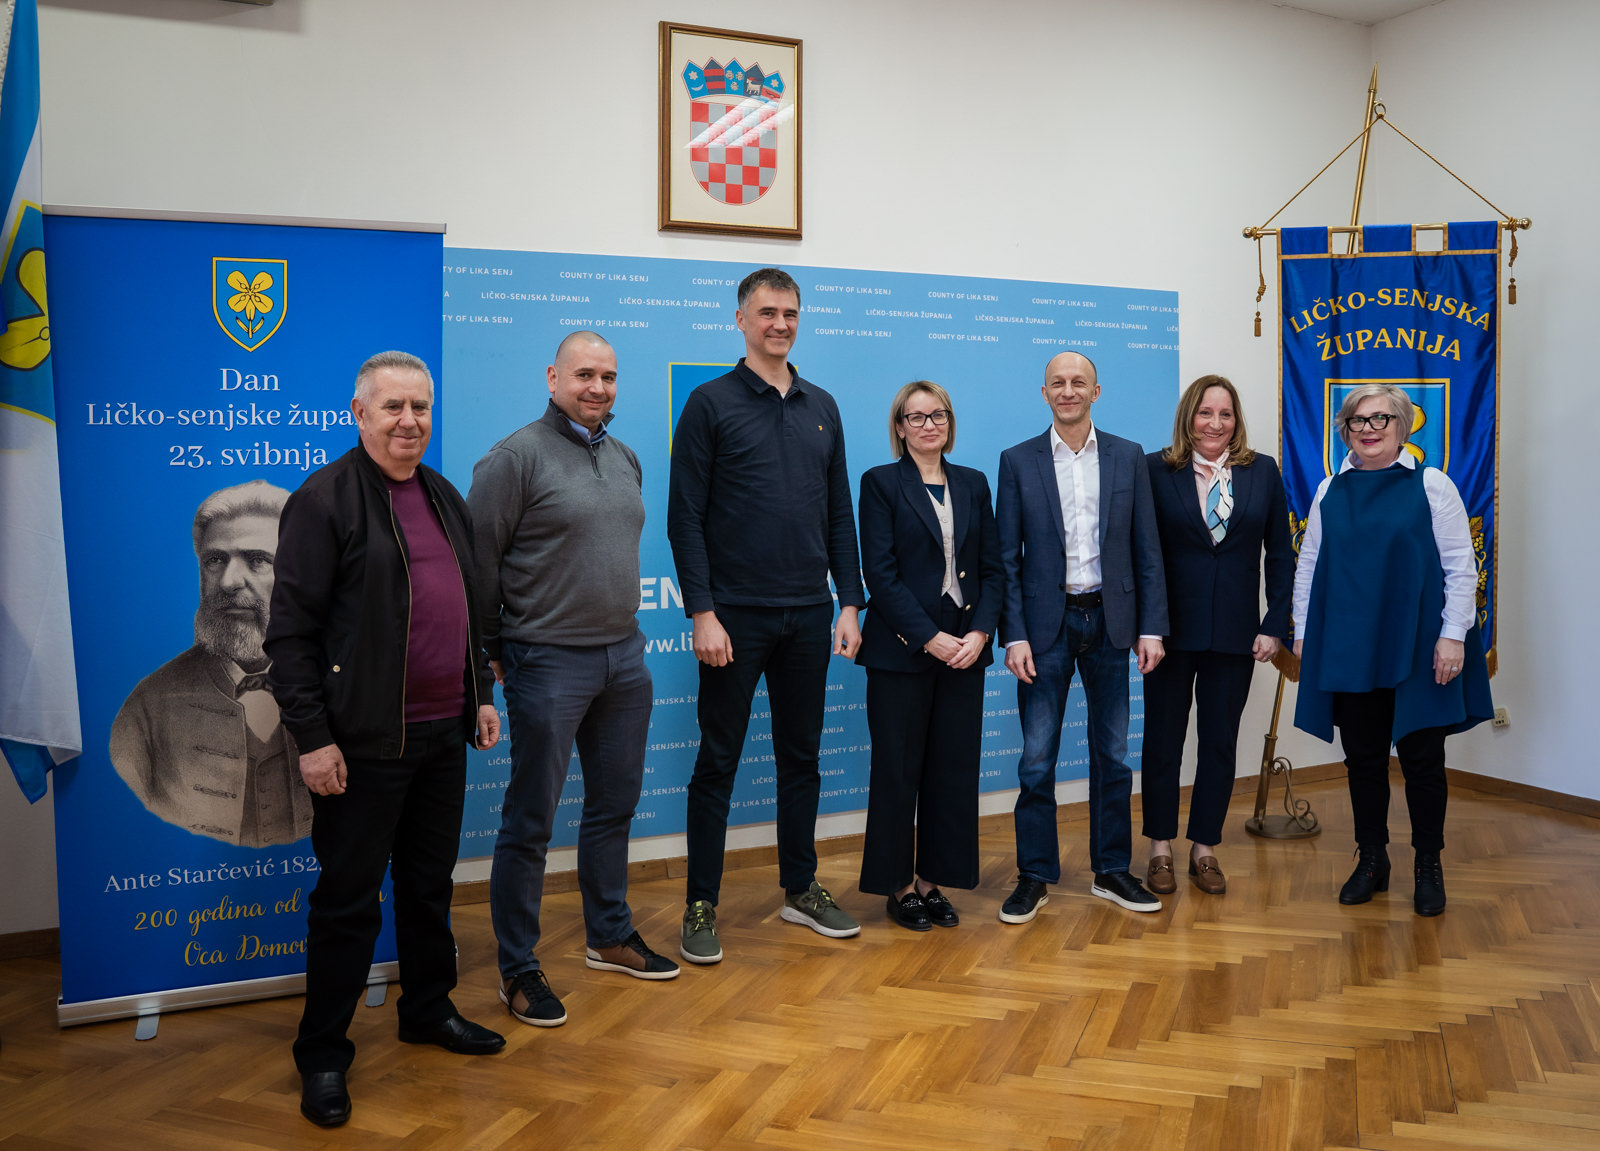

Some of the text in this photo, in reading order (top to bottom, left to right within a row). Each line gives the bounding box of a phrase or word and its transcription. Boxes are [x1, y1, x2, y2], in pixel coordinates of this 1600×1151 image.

[560, 271, 593, 279] COUNTY
[692, 278, 724, 286] COUNTY
[814, 284, 844, 292] COUNTY
[481, 290, 590, 303] LIČKO-SENJSKA ŽUPANIJA
[619, 296, 720, 308] LIČKO-SENJSKA ŽUPANIJA
[807, 304, 841, 314] ŽUPANIJA
[866, 308, 952, 320] LIČKO-SENJSKA ŽUPANIJA
[1288, 288, 1490, 333] LIČKO-SENJSKA
[560, 318, 593, 326] COUNTY
[975, 314, 1054, 325] LIČKO-SENJSKA ŽUPANIJA
[1075, 320, 1148, 330] LIČKO-SENJSKA ŽUPANIJA
[1316, 328, 1460, 361] ŽUPANIJA
[220, 368, 280, 391] Dan
[86, 402, 358, 432] Ličko-senjske župa
[170, 441, 330, 471] 23. svibnja
[818, 747, 847, 756] COUNTY
[742, 756, 759, 764] LIKA
[818, 768, 845, 776] PANIJA
[477, 782, 497, 790] LIKA
[819, 789, 848, 798] COUNTY
[742, 800, 760, 808] LIKA
[636, 811, 656, 820] SENJ
[465, 828, 499, 839] OF LIKA
[104, 856, 322, 892] Ante Starčević 182
[134, 888, 302, 938] 200 godina od
[184, 941, 227, 966] Oca
